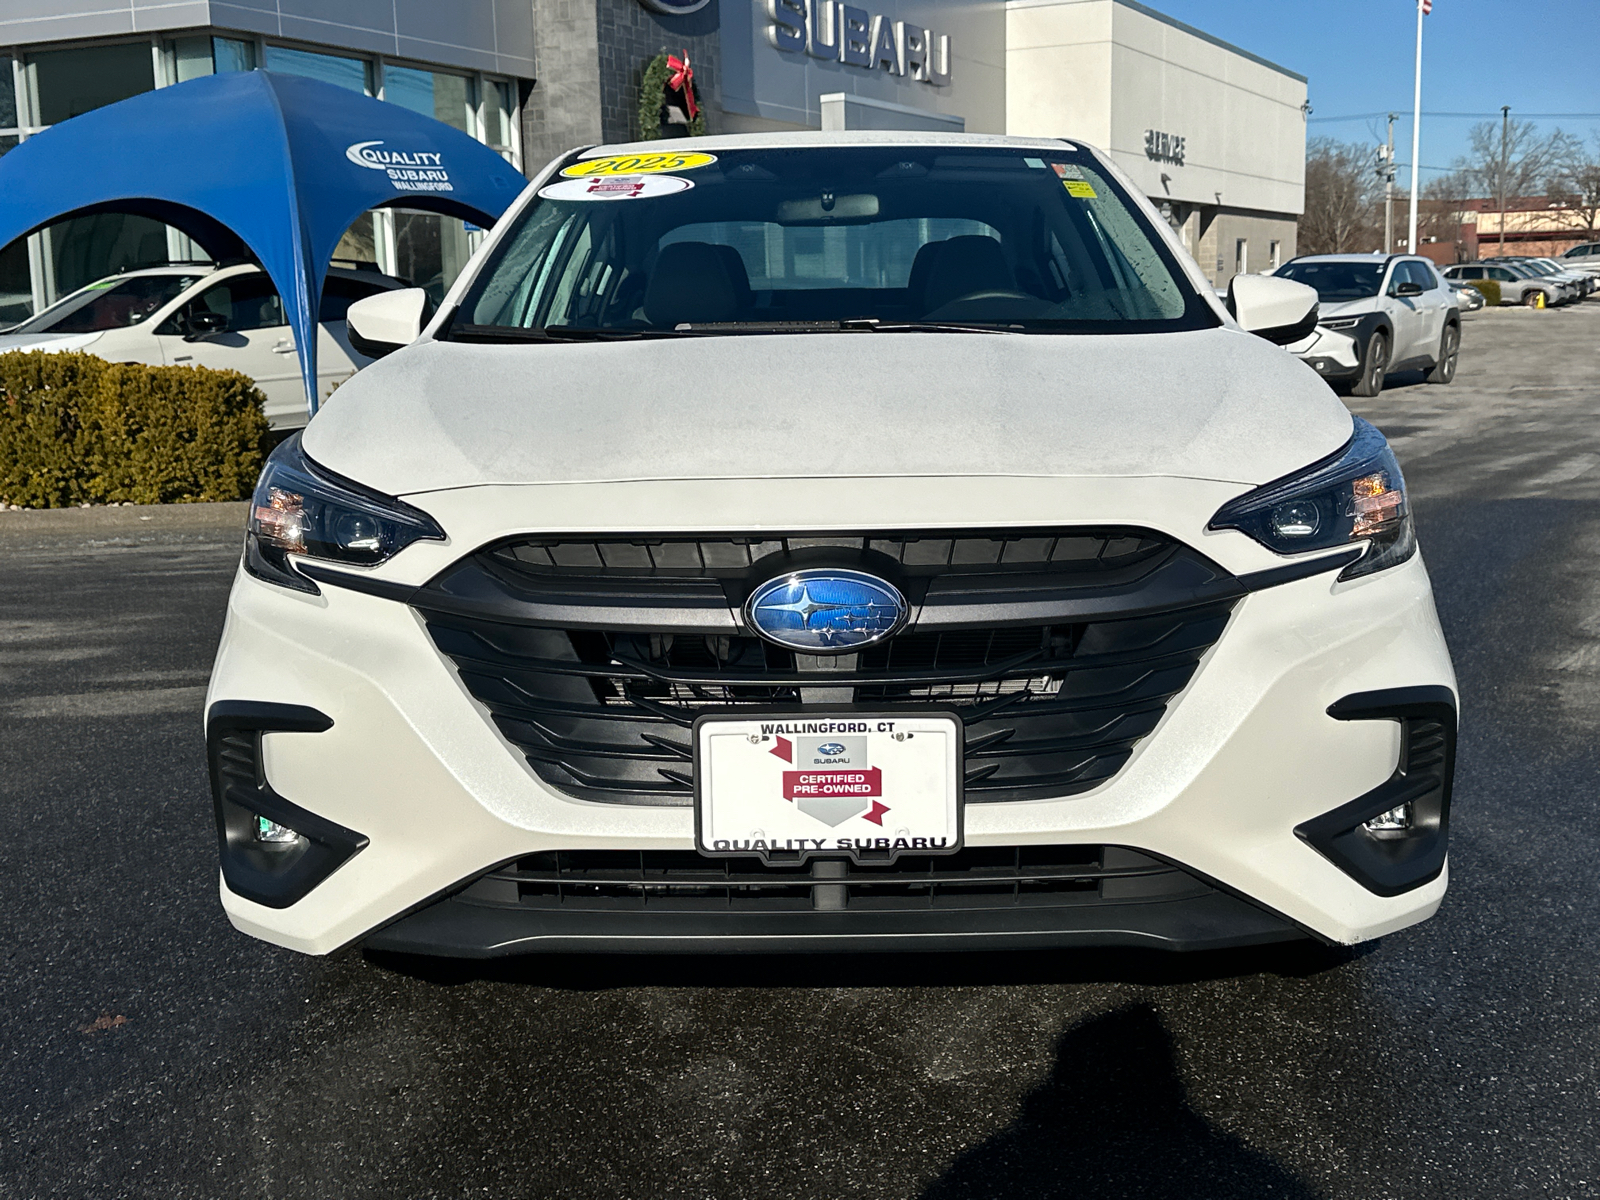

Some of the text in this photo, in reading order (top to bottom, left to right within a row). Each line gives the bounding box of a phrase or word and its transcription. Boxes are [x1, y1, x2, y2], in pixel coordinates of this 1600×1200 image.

[765, 0, 951, 86] SUBARU
[362, 149, 441, 165] QUALITY
[585, 155, 692, 175] 2025
[386, 168, 449, 181] SUBARU
[391, 180, 454, 191] WALLINGFORD
[877, 722, 895, 733] CT
[799, 774, 865, 784] CERTIFIED
[793, 783, 872, 794] PRE-OWNED
[713, 836, 947, 851] QUALITY SUBARU
